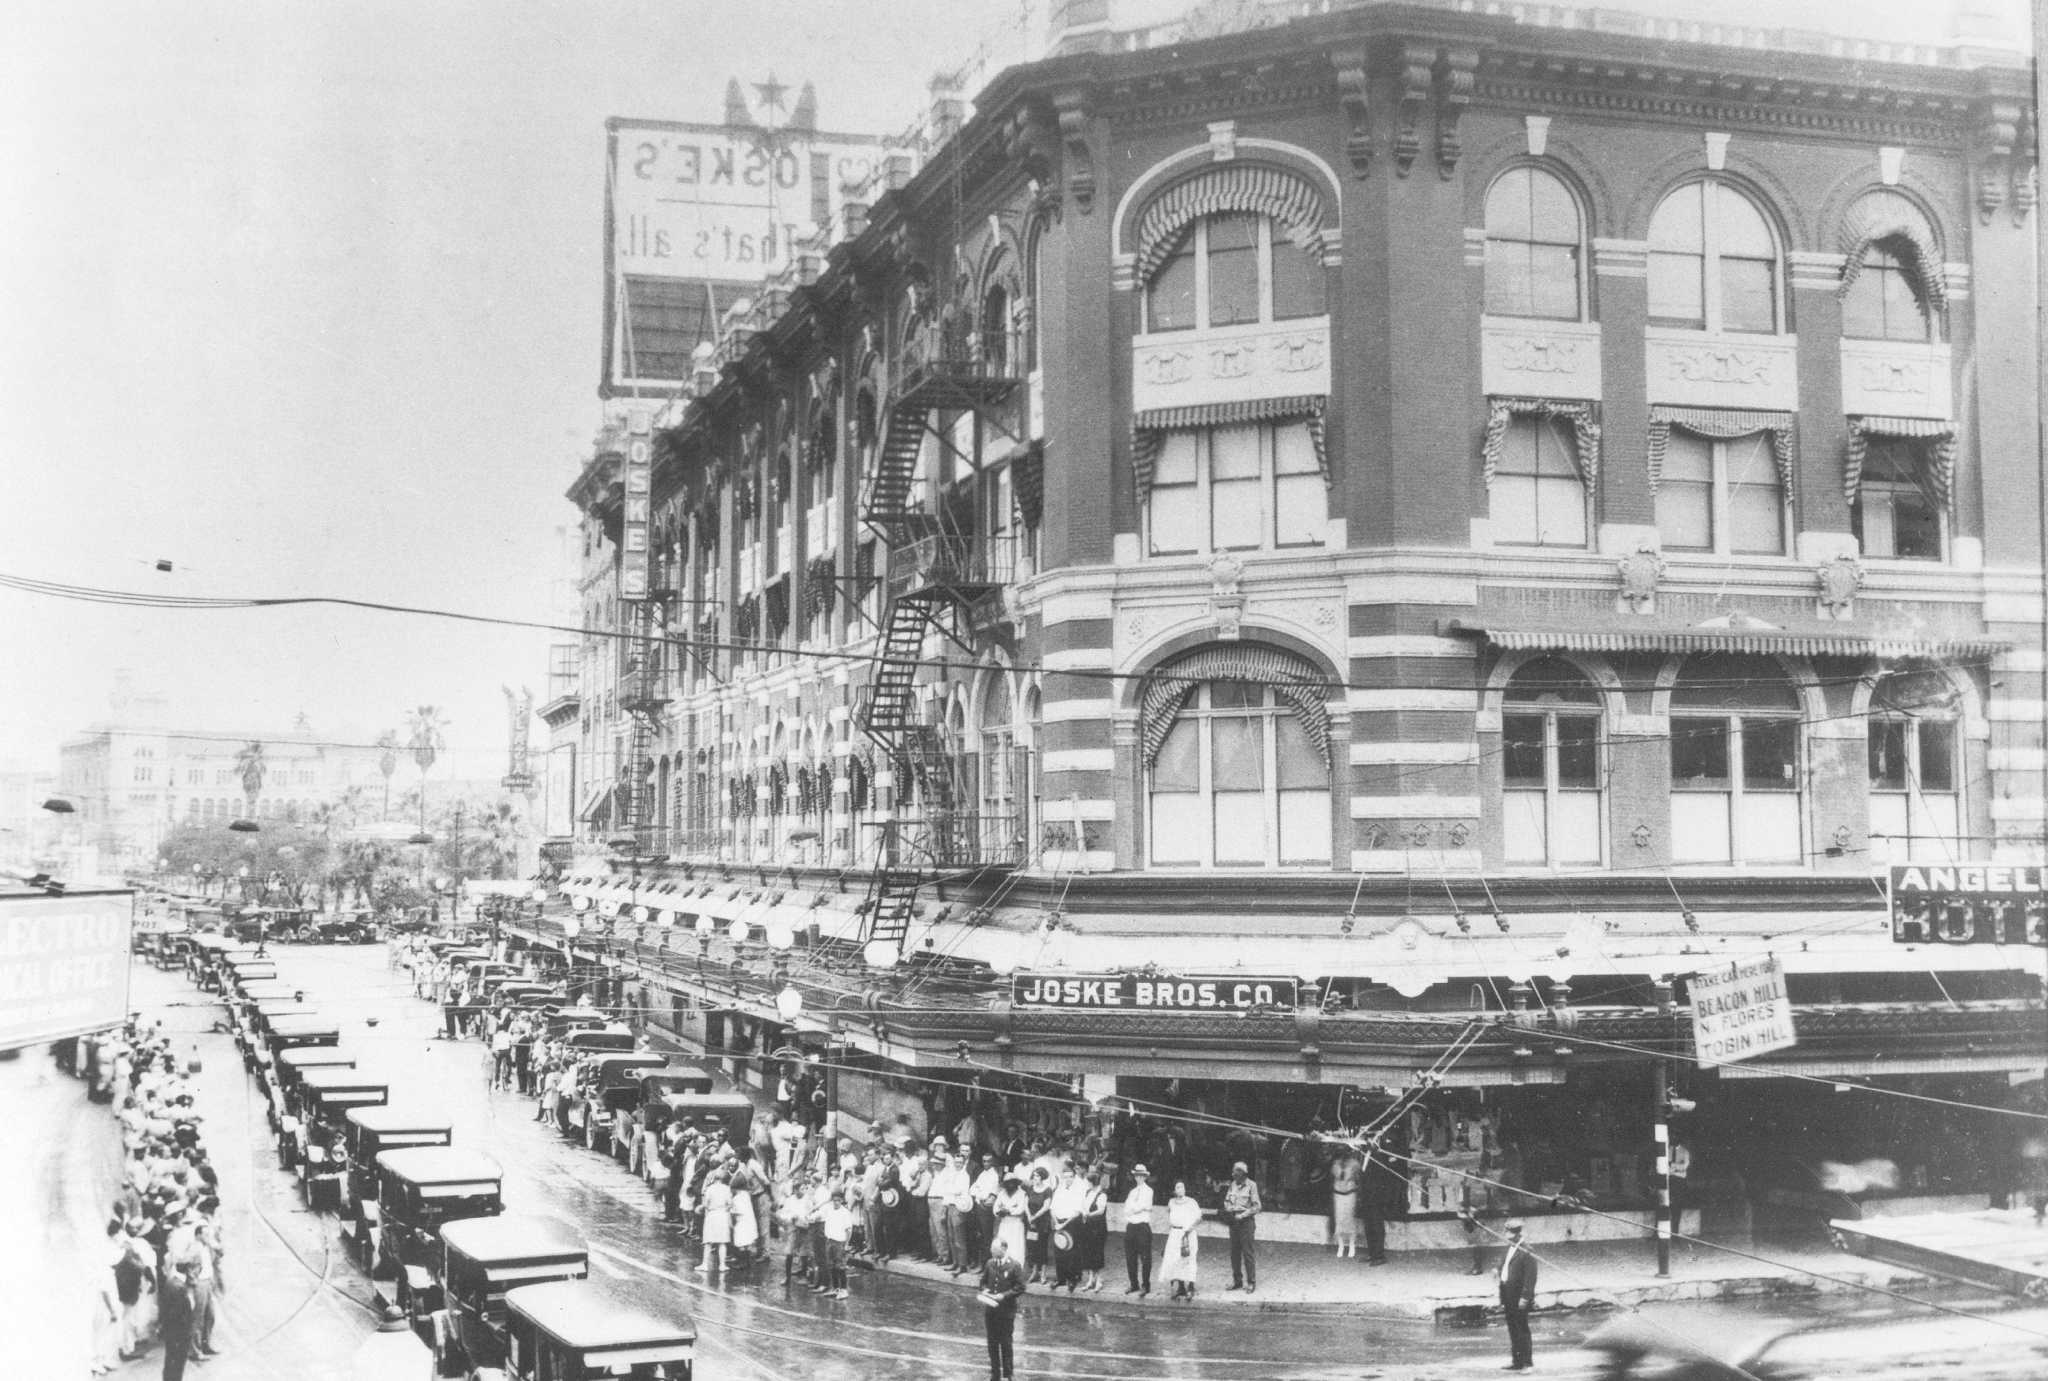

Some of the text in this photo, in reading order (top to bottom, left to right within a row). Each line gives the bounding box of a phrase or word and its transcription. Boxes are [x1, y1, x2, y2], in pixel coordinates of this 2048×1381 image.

[1898, 867, 2048, 892] ANGEL
[1023, 979, 1122, 1005] JOSKE
[1136, 982, 1227, 1008] BROS.
[1697, 981, 1782, 1019] BEACON HILL
[1722, 1003, 1774, 1029] FLORES
[1700, 1024, 1788, 1057] TOBIN HILL
